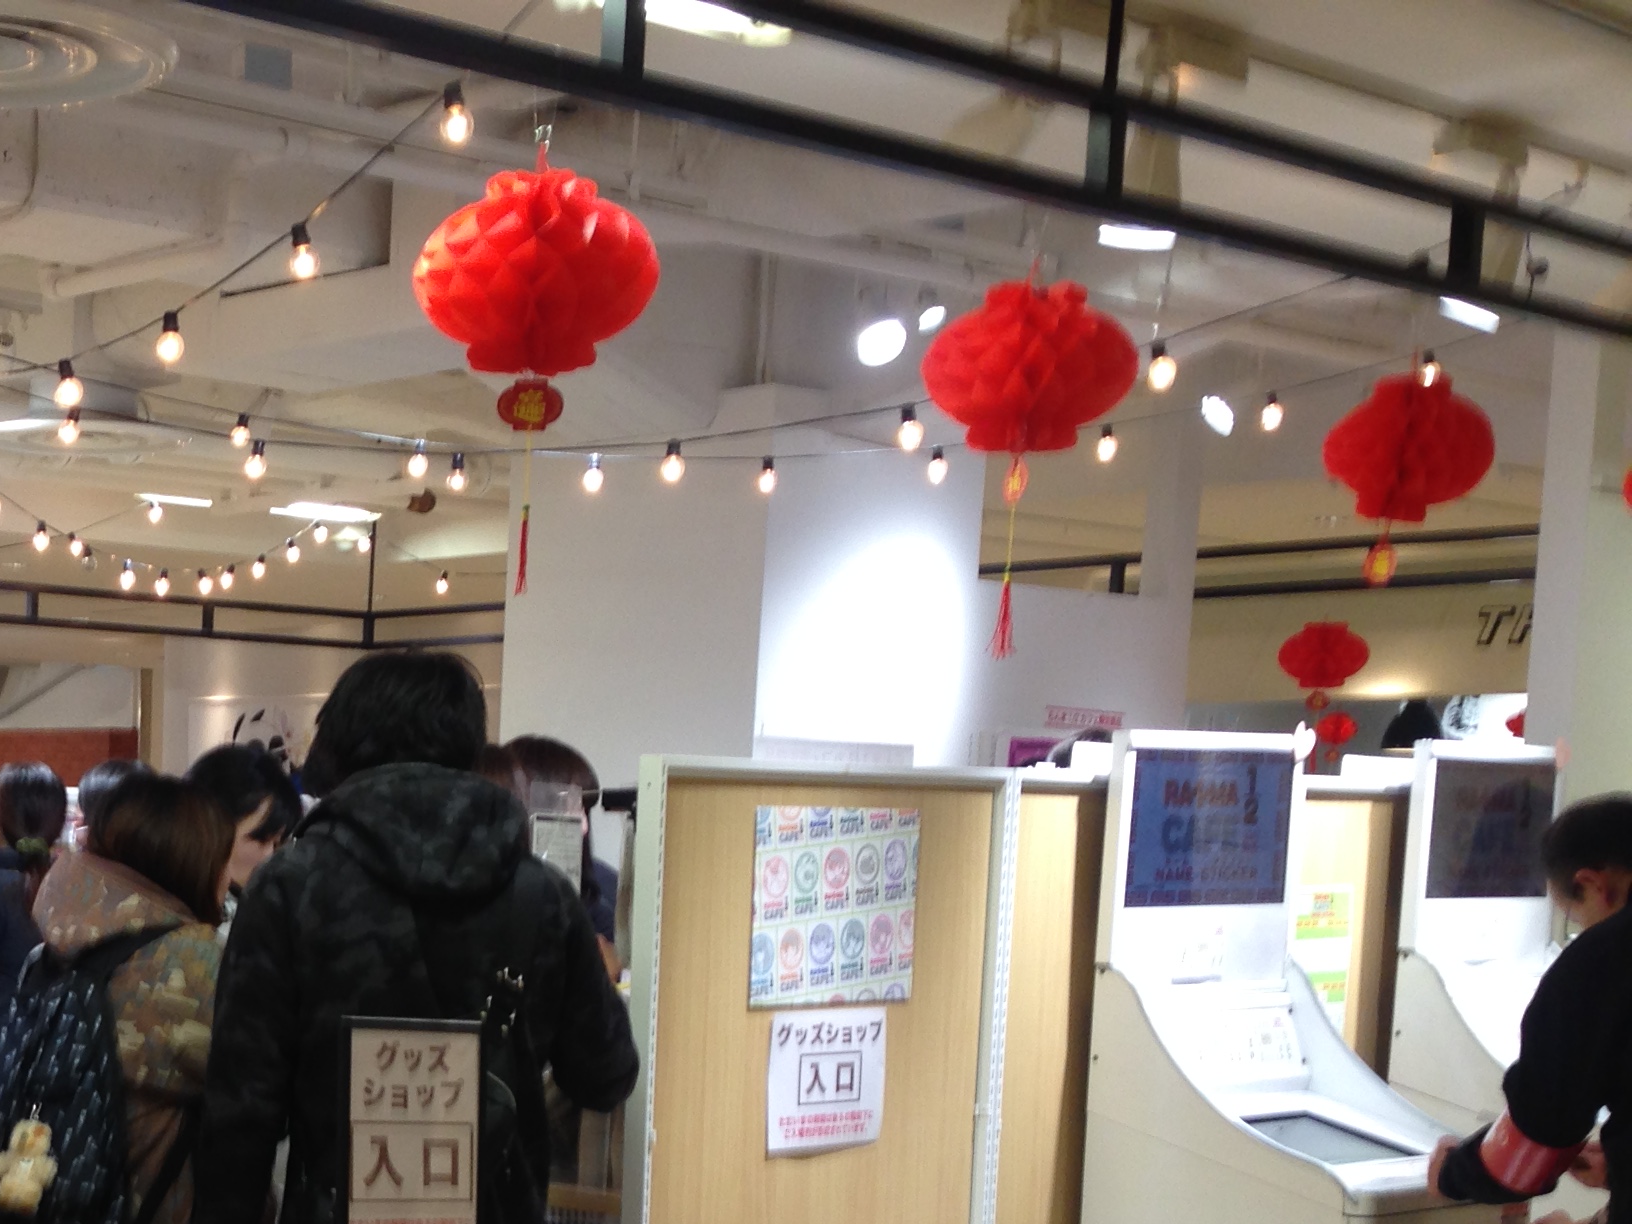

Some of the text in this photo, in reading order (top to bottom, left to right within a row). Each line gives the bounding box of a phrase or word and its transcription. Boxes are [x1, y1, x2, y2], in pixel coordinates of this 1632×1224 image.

[777, 1019, 882, 1047] グッズショップ
[376, 1040, 451, 1072] グッズ
[363, 1077, 465, 1109] ショップ
[806, 1062, 855, 1094] 入口
[363, 1135, 460, 1187] 入口
